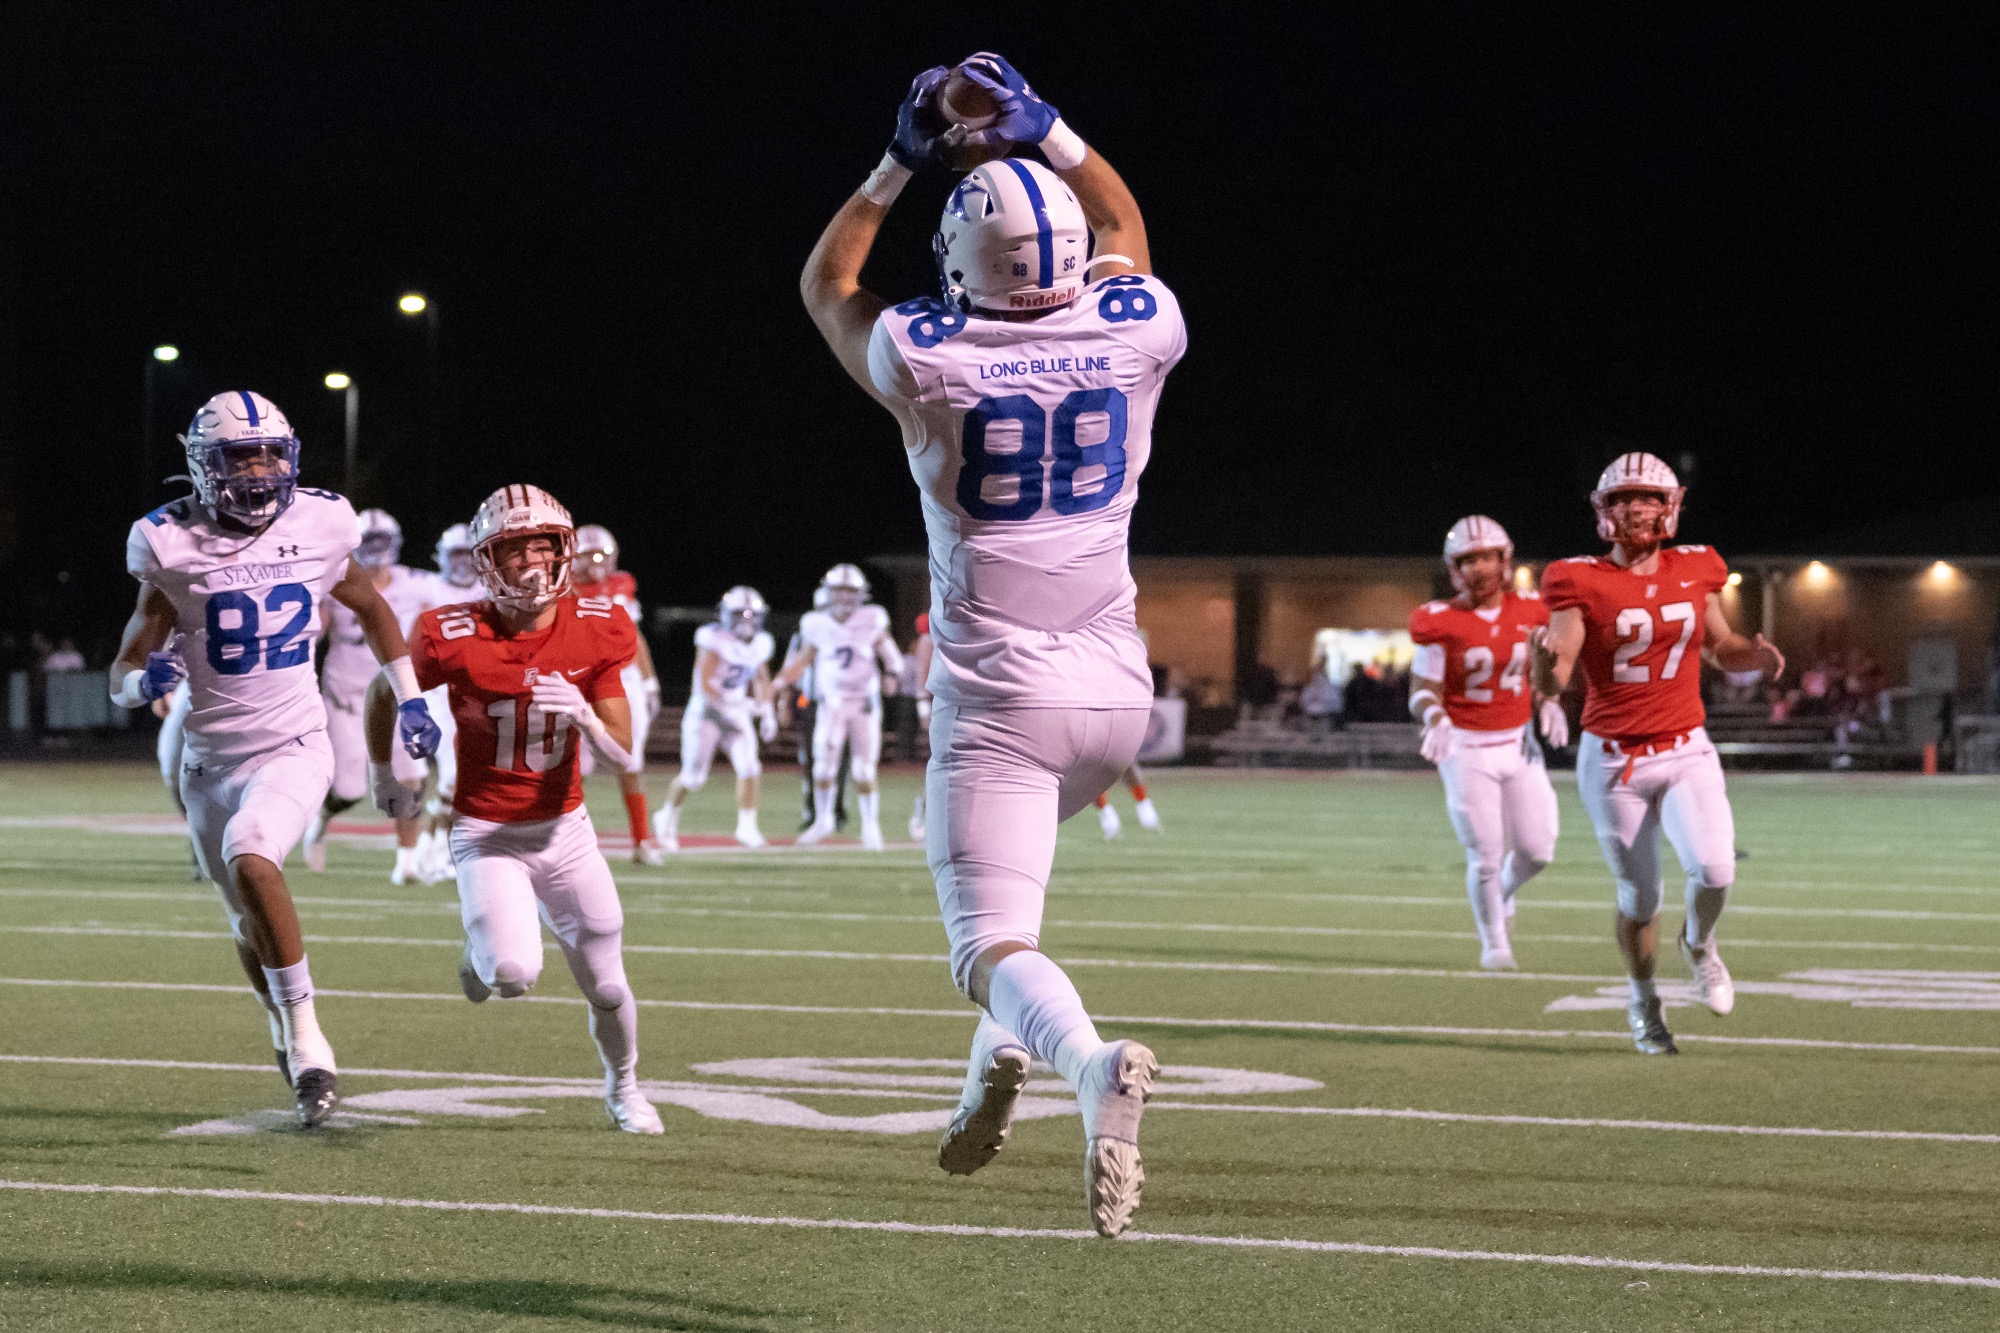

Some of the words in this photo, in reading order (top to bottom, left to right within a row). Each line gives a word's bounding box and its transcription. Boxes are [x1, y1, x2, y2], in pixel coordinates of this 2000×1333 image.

[1012, 262, 1029, 277] 88
[1063, 256, 1076, 272] SC
[1009, 286, 1077, 308] Riddell
[979, 361, 1028, 380] LONG
[1030, 358, 1074, 375] BLUE
[1075, 356, 1111, 372] LINE
[955, 387, 1129, 522] 88
[576, 596, 615, 619] 10
[205, 583, 312, 675] 82
[437, 608, 477, 640] 10
[1613, 602, 1696, 683] 27
[1463, 642, 1528, 703] 24
[487, 698, 572, 773] 10
